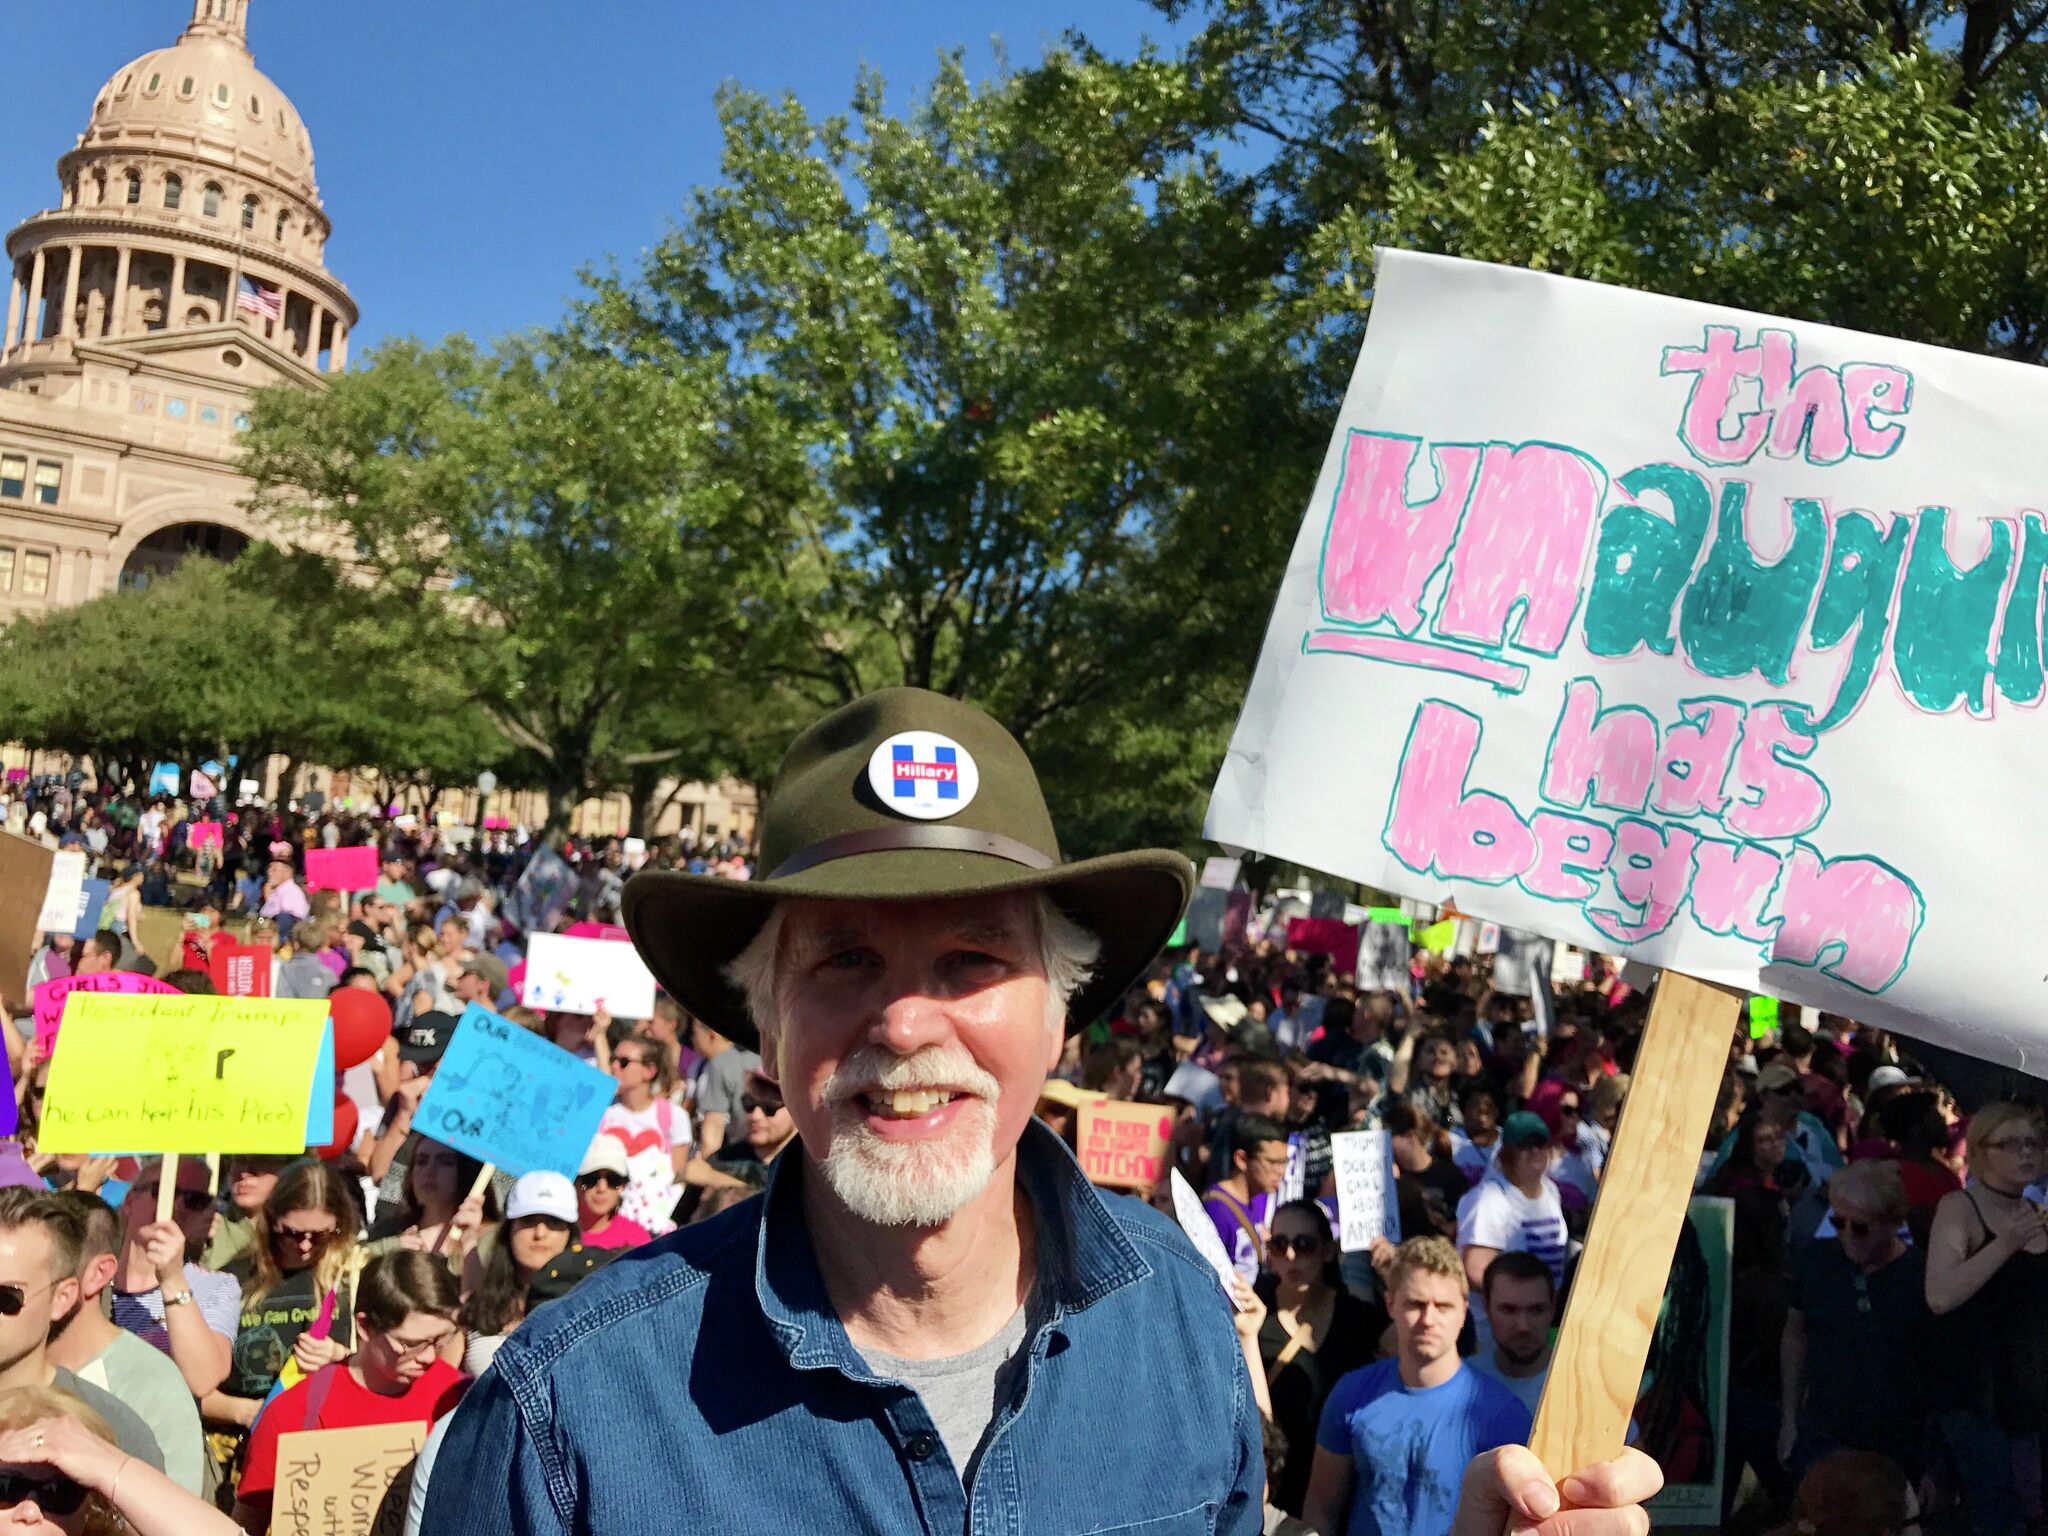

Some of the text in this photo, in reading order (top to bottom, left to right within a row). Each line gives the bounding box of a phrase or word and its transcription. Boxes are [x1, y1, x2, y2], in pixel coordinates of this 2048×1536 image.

[1661, 325, 1913, 467] the
[1318, 428, 2048, 734] unaugur
[896, 763, 954, 781] Hillary
[1540, 676, 1829, 840] has
[1381, 698, 1925, 995] begun
[210, 1002, 300, 1027] Trump
[473, 1014, 510, 1043] OUR
[408, 1028, 437, 1047] ATX
[45, 1096, 75, 1123] he
[86, 1107, 129, 1123] can
[187, 1096, 225, 1122] his
[441, 1107, 485, 1138] OUR
[264, 1310, 288, 1325] Can
